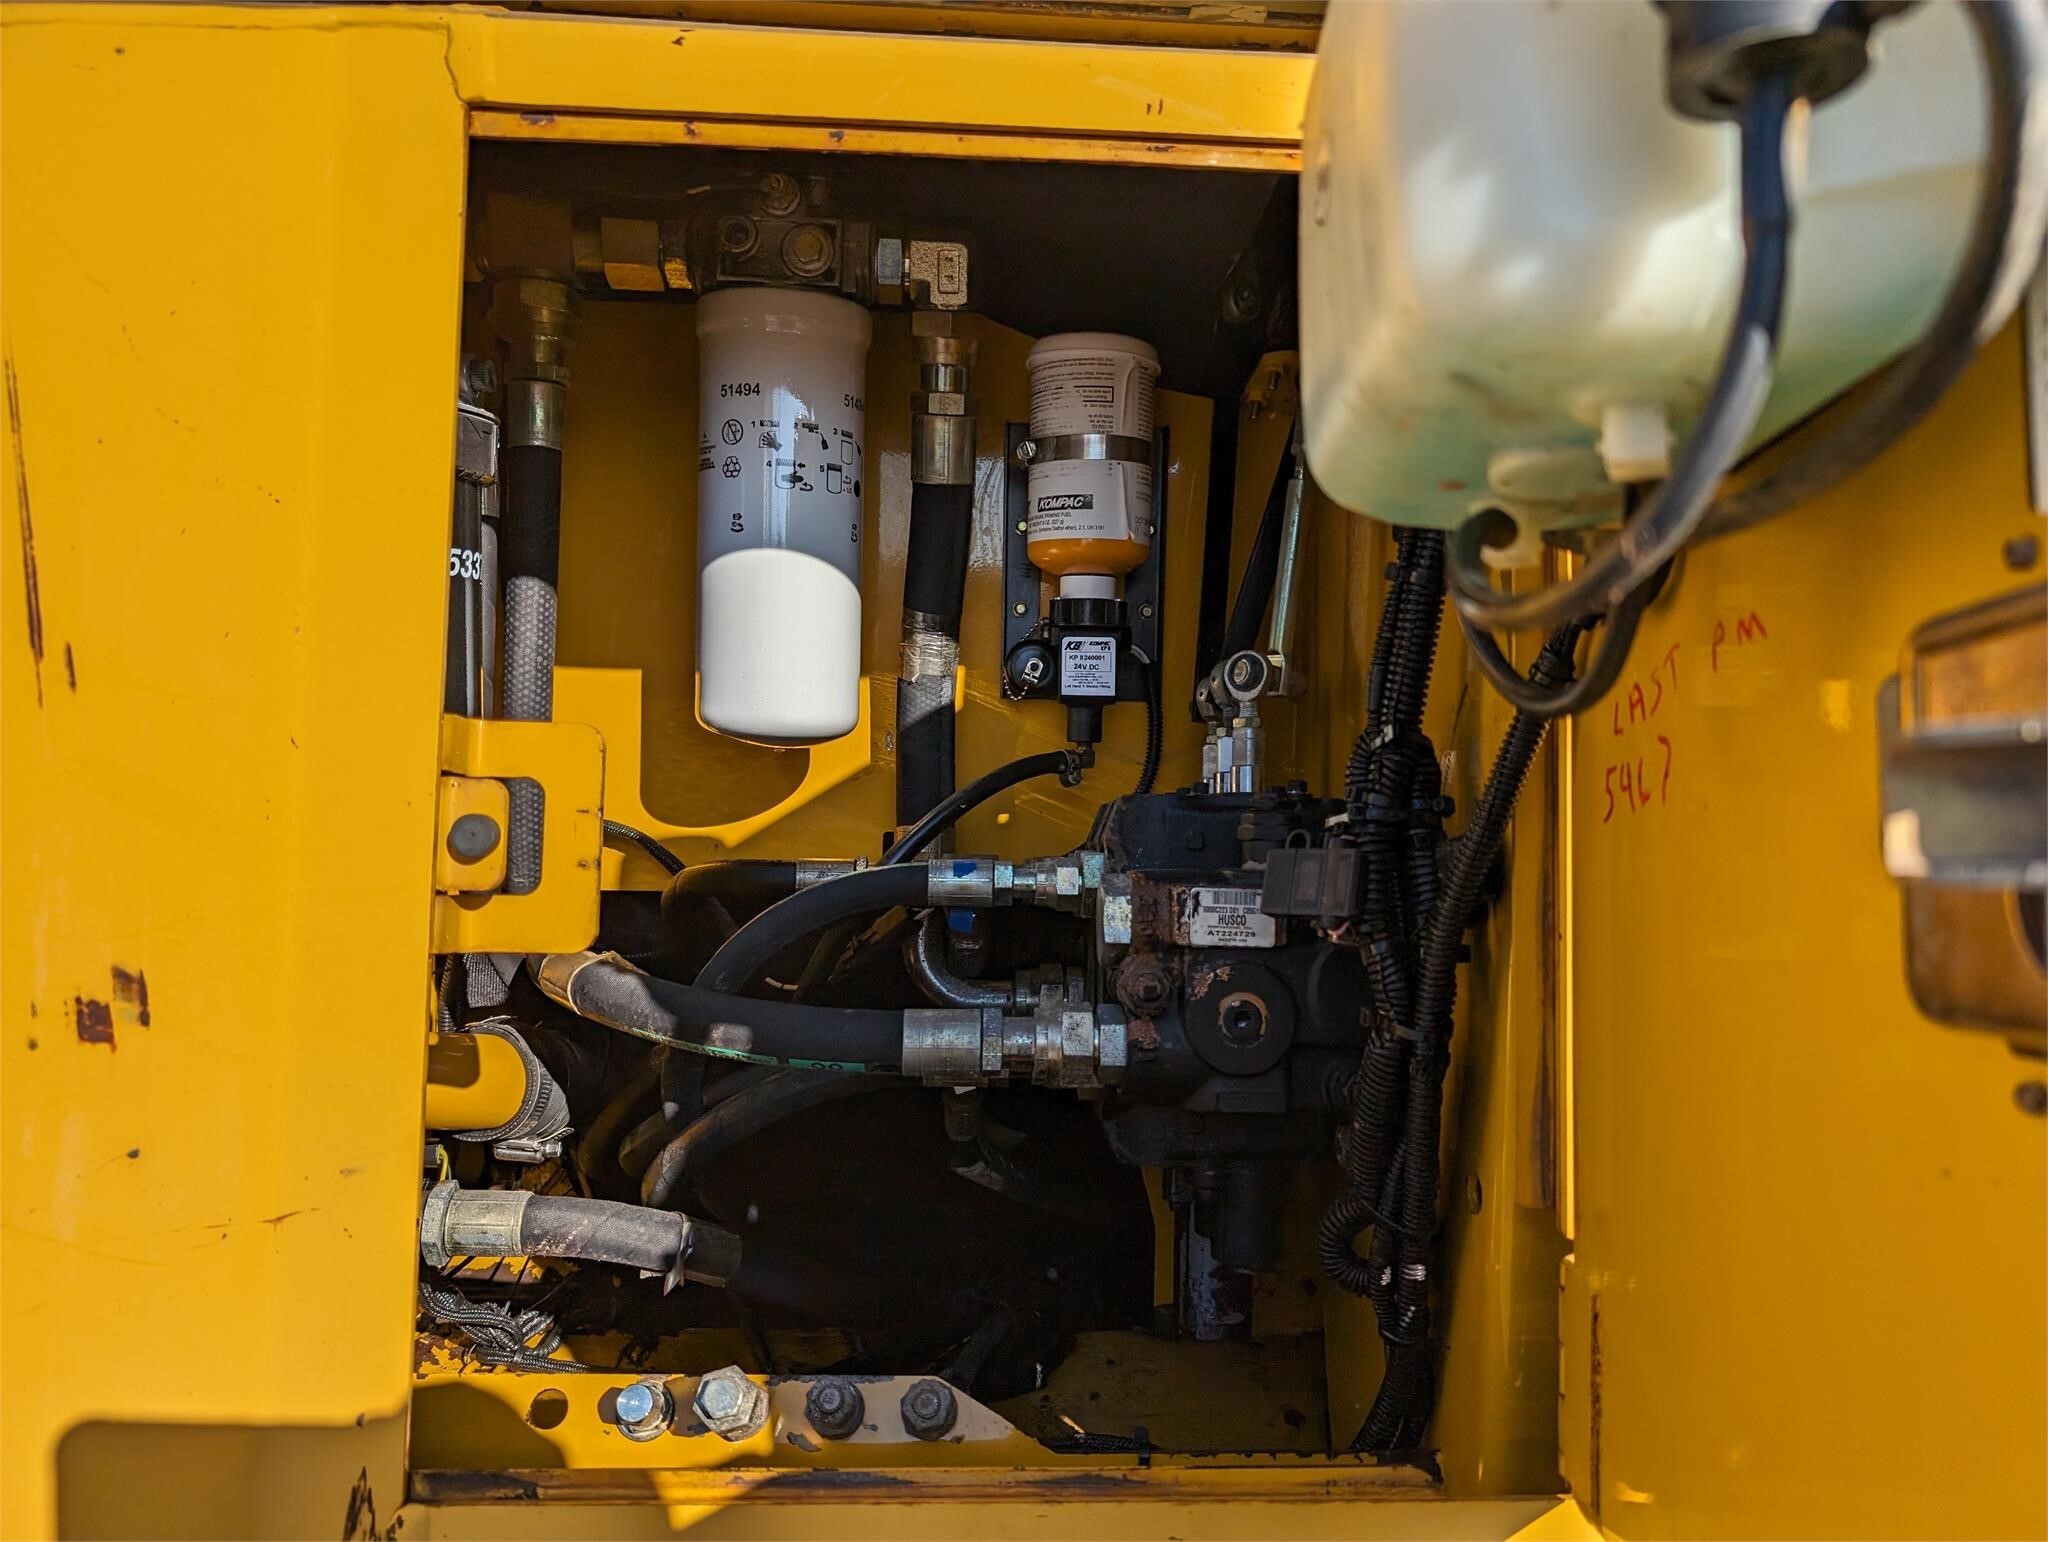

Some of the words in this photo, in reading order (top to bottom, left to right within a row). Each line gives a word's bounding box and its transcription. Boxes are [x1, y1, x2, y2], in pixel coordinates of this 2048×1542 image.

[720, 382, 761, 398] 51494
[750, 420, 756, 429] 1
[832, 427, 838, 436] 3
[766, 460, 772, 468] 4
[819, 465, 825, 473] 5
[1038, 496, 1084, 511] KOMPAC
[1613, 642, 1681, 736] LAST
[1603, 734, 1672, 824] 5467
[1218, 914, 1247, 926] HUSCO
